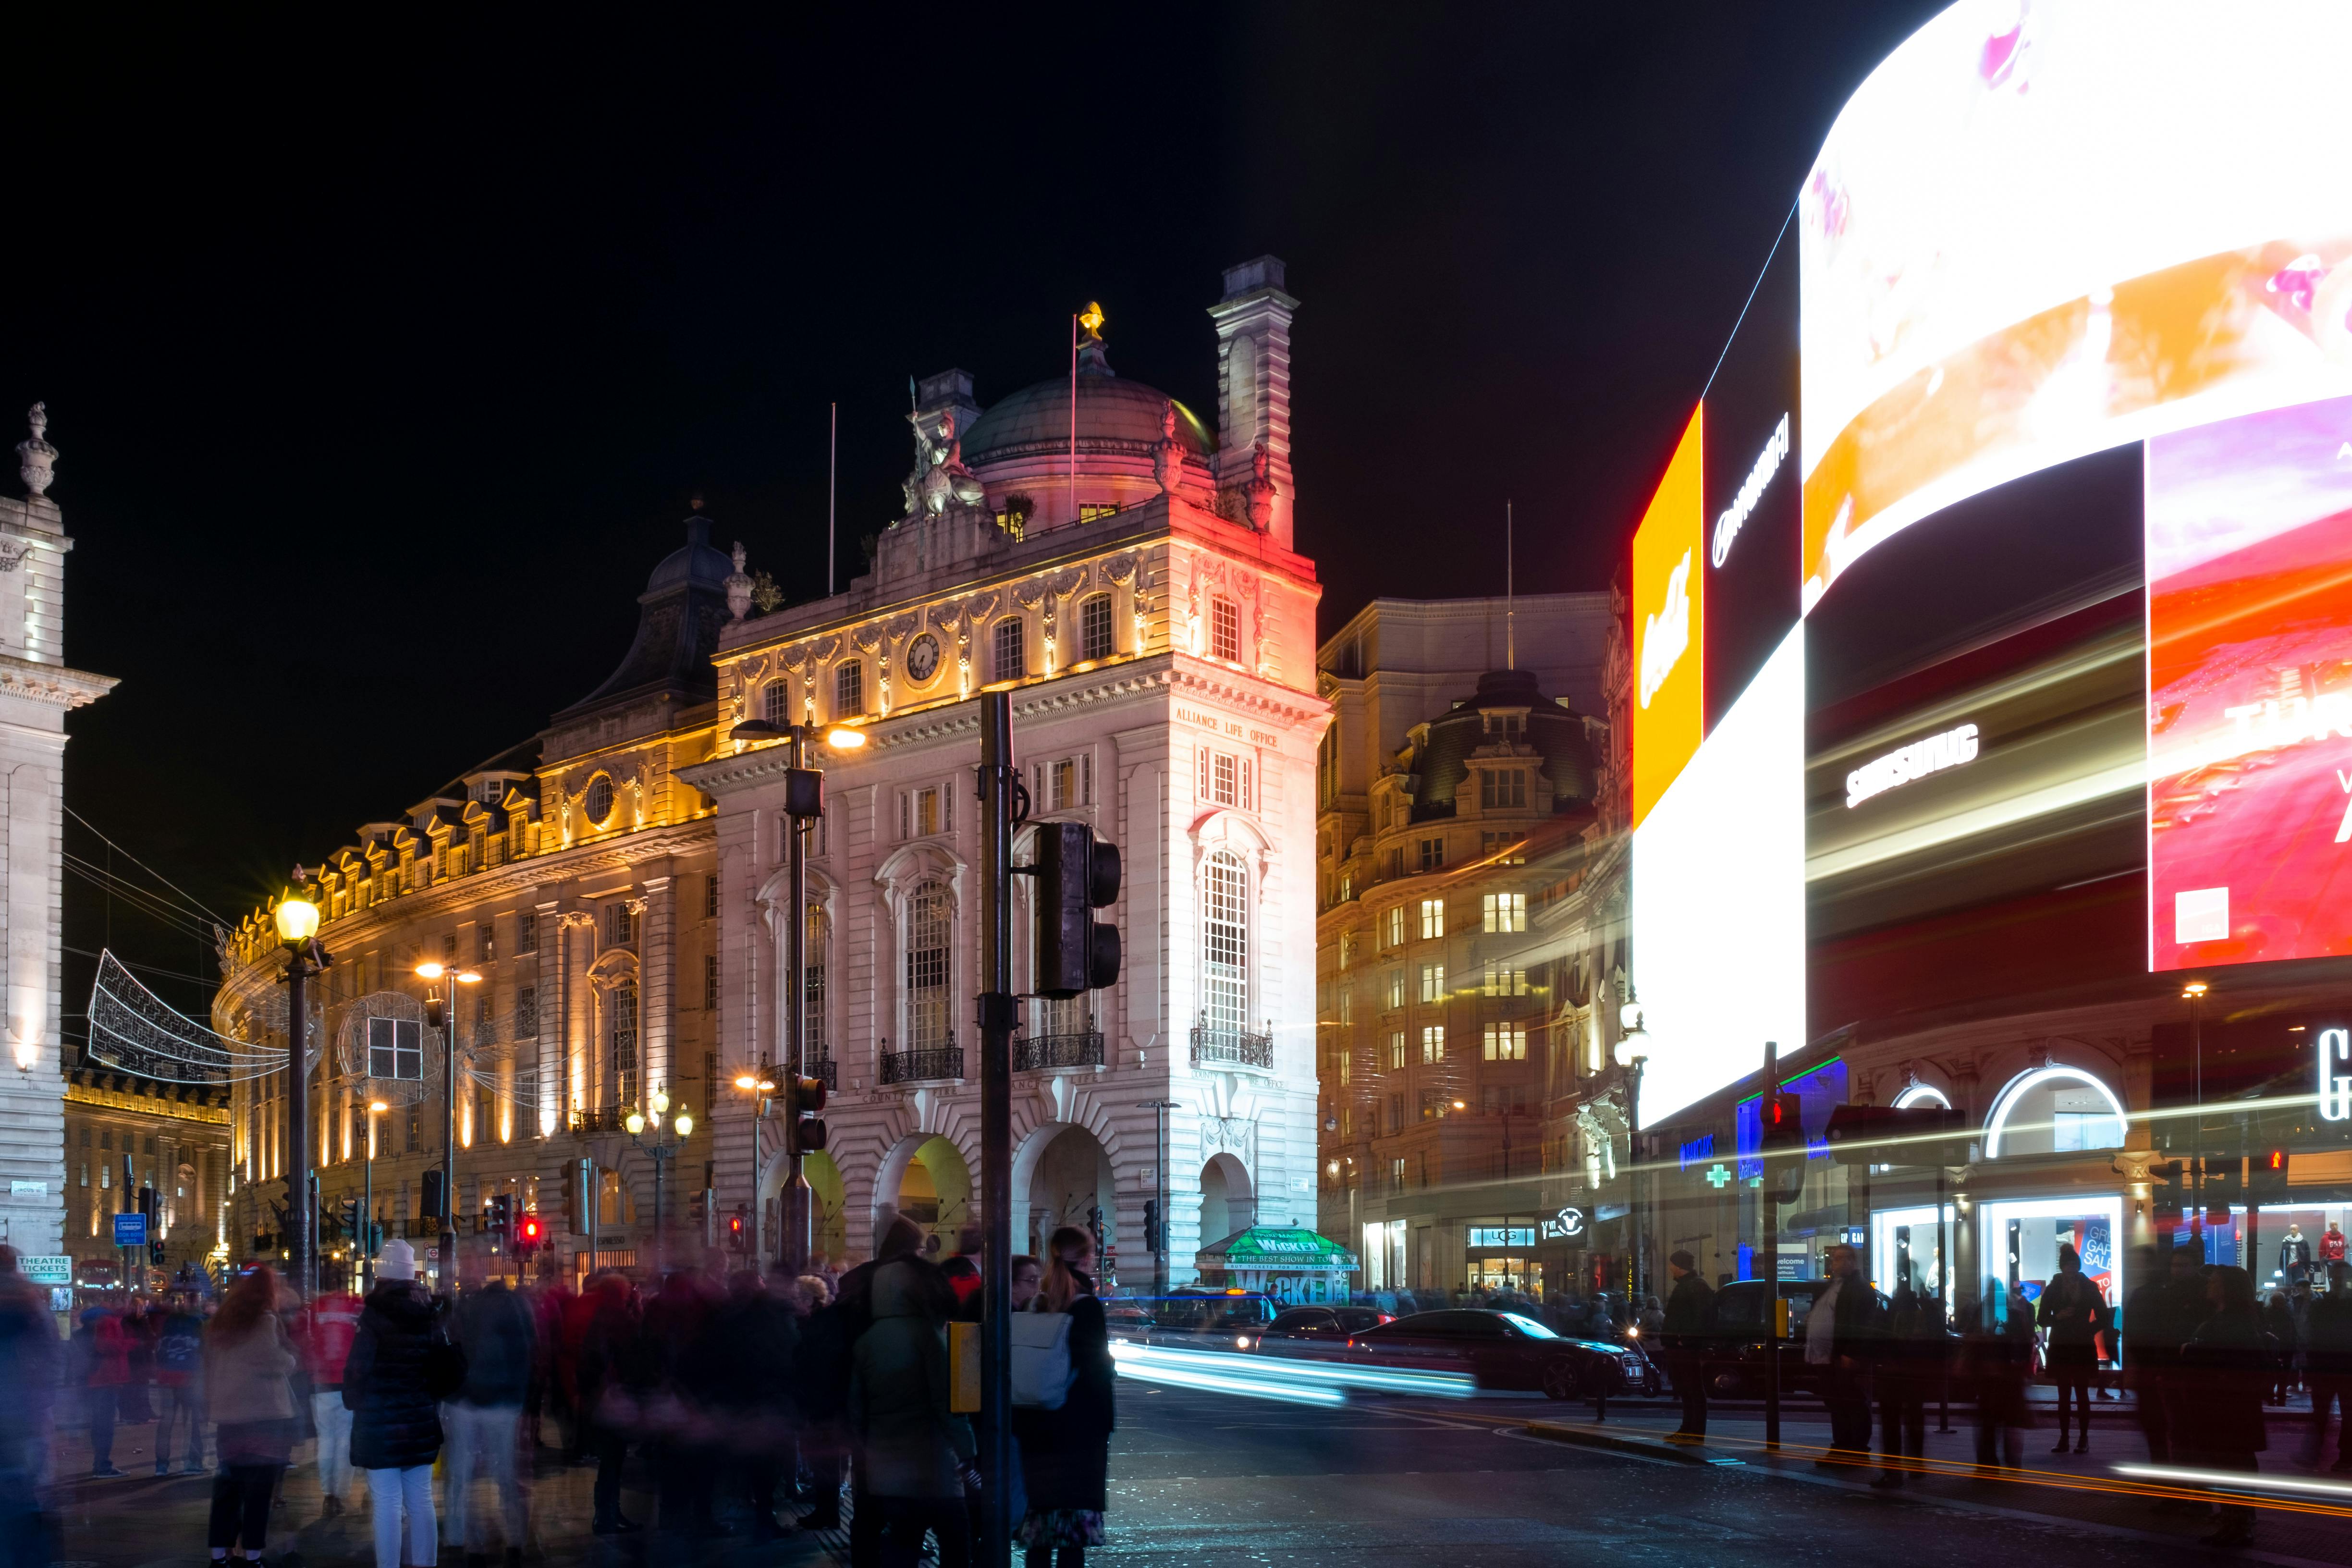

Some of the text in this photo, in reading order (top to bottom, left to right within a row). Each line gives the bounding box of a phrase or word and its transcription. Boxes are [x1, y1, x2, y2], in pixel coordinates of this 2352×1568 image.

[1177, 708, 1277, 747] ALLIANCE LIFE OFFICE
[863, 1074, 1098, 1103] COUNTY FIRE ANCE LIFE
[2097, 1277, 2109, 1288] TO
